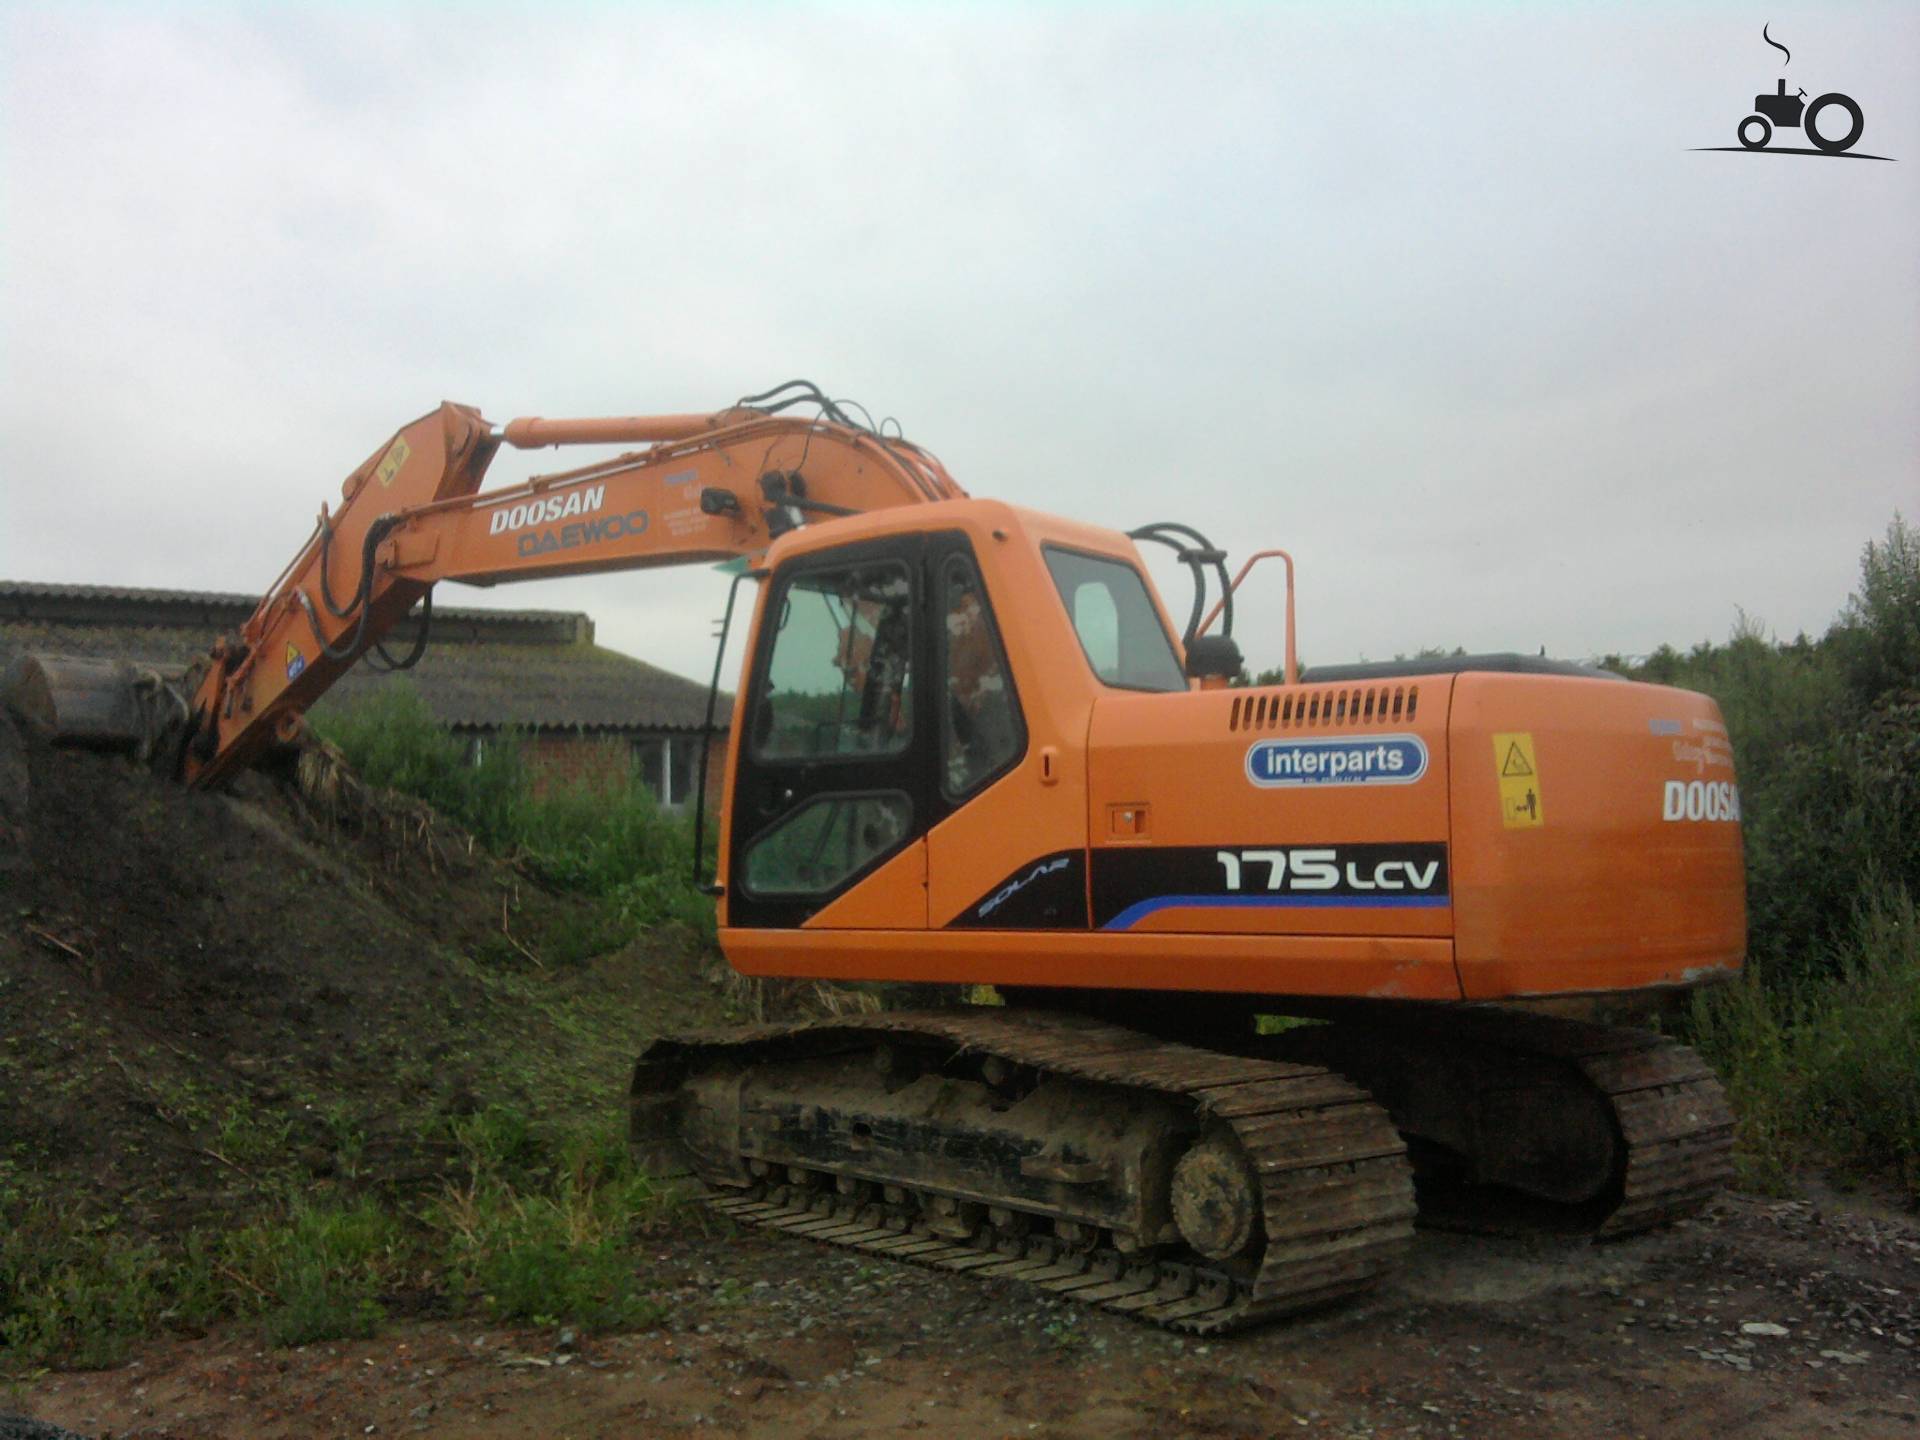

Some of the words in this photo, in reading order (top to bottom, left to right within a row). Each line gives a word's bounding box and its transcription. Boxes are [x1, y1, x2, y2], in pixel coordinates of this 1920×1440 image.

[490, 486, 605, 534] DOOSAN
[518, 510, 648, 557] DAEWOO
[1267, 746, 1404, 776] interparts
